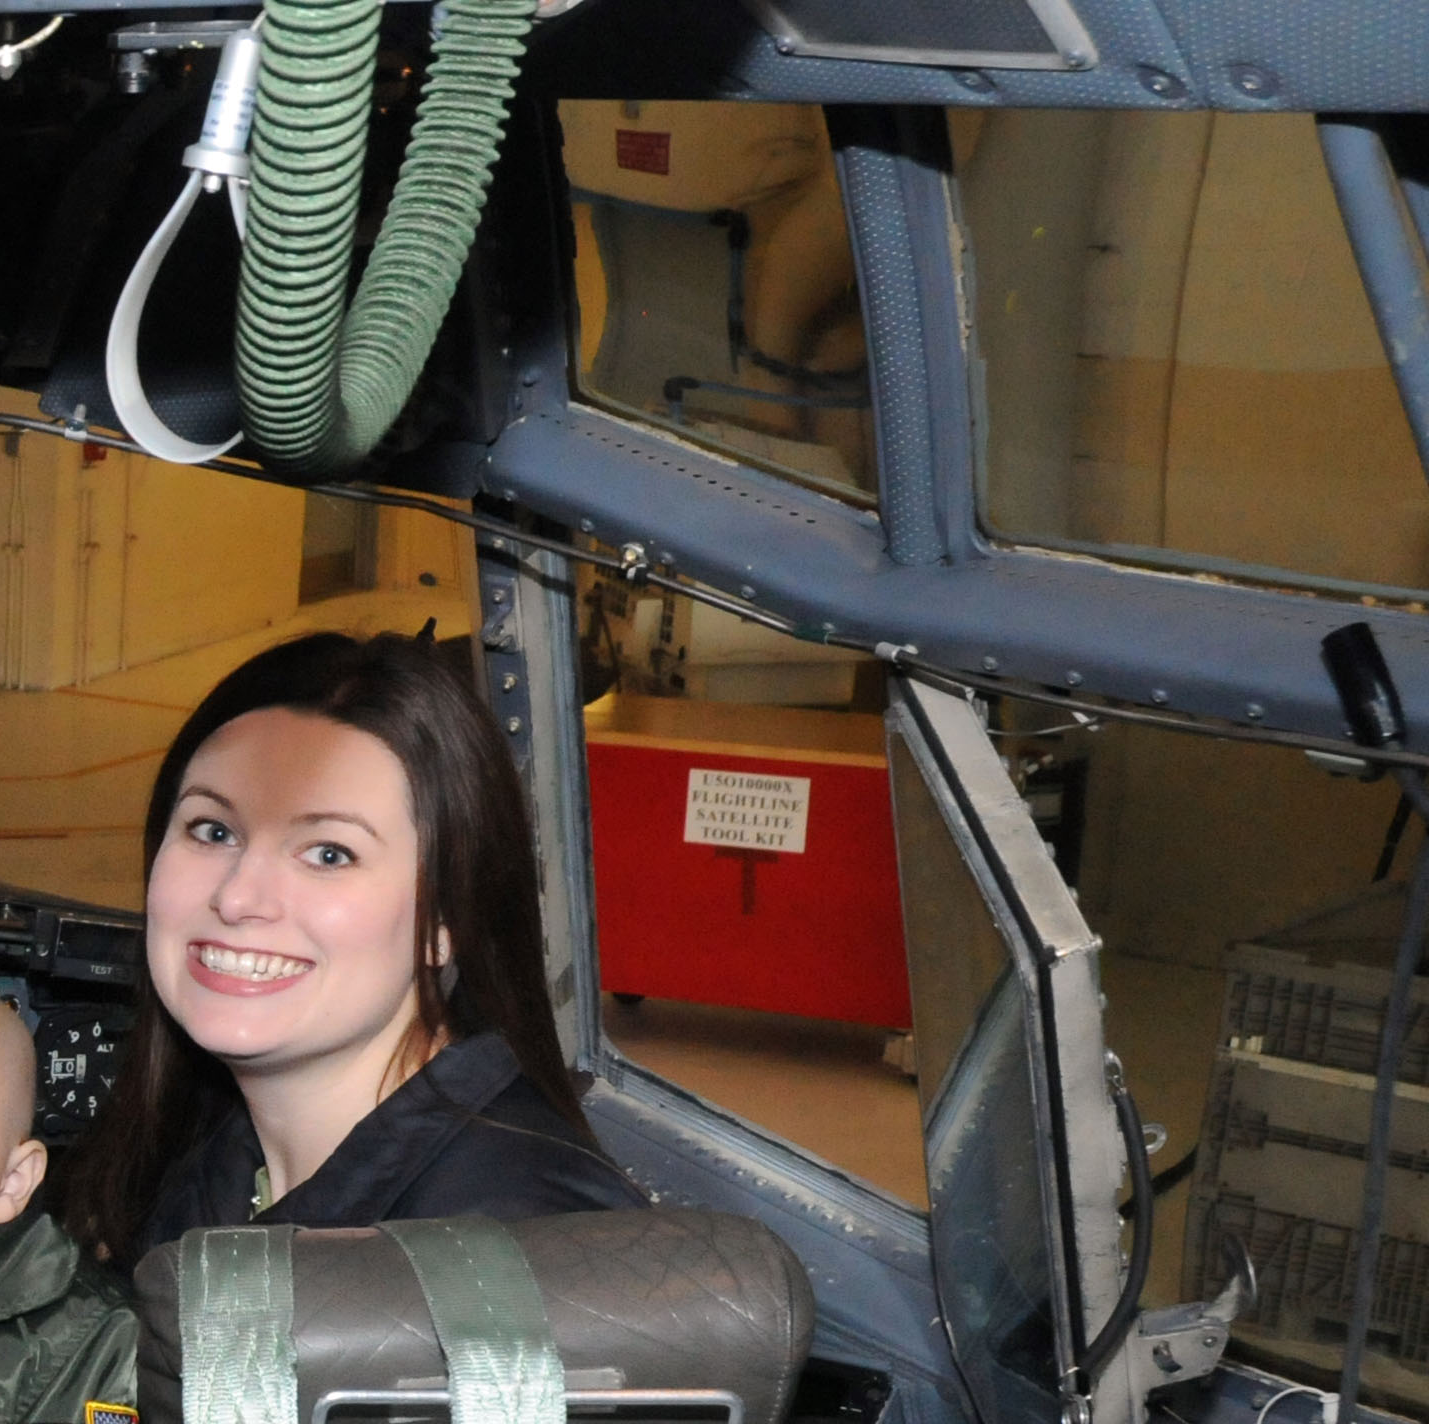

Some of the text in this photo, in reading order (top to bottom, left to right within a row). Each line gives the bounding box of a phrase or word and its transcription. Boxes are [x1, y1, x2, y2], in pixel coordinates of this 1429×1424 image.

[692, 790, 801, 813] FLIGHTLINE
[696, 808, 794, 829] SATELLITE
[701, 826, 787, 846] TOOL KIT
[91, 965, 112, 974] TEST
[71, 1032, 80, 1042] 9
[97, 1044, 114, 1052] ALT
[67, 1091, 76, 1101] 6
[88, 1096, 97, 1107] 5
